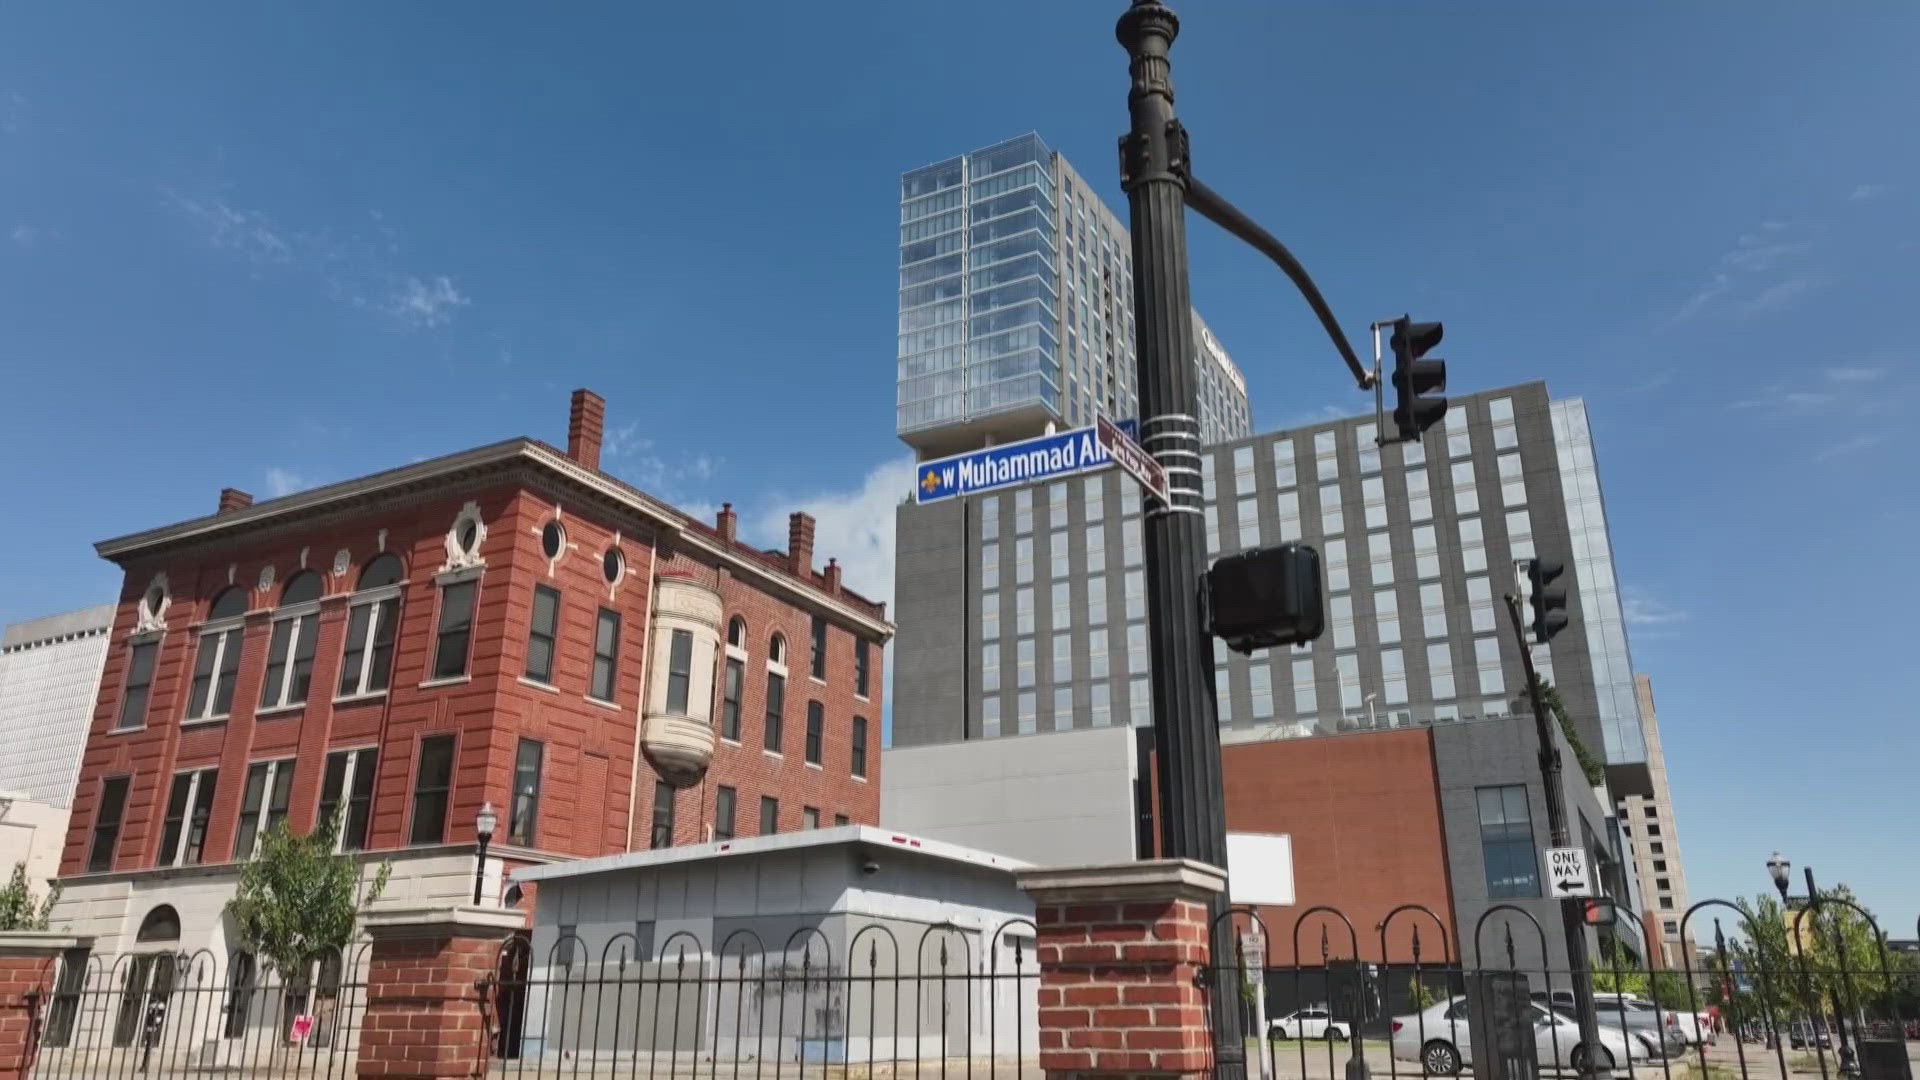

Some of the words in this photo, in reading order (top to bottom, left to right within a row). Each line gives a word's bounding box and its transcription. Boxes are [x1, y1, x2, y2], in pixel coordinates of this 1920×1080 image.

[942, 467, 955, 490] W
[959, 436, 1076, 491] Muhammad
[1553, 864, 1581, 877] WAY
